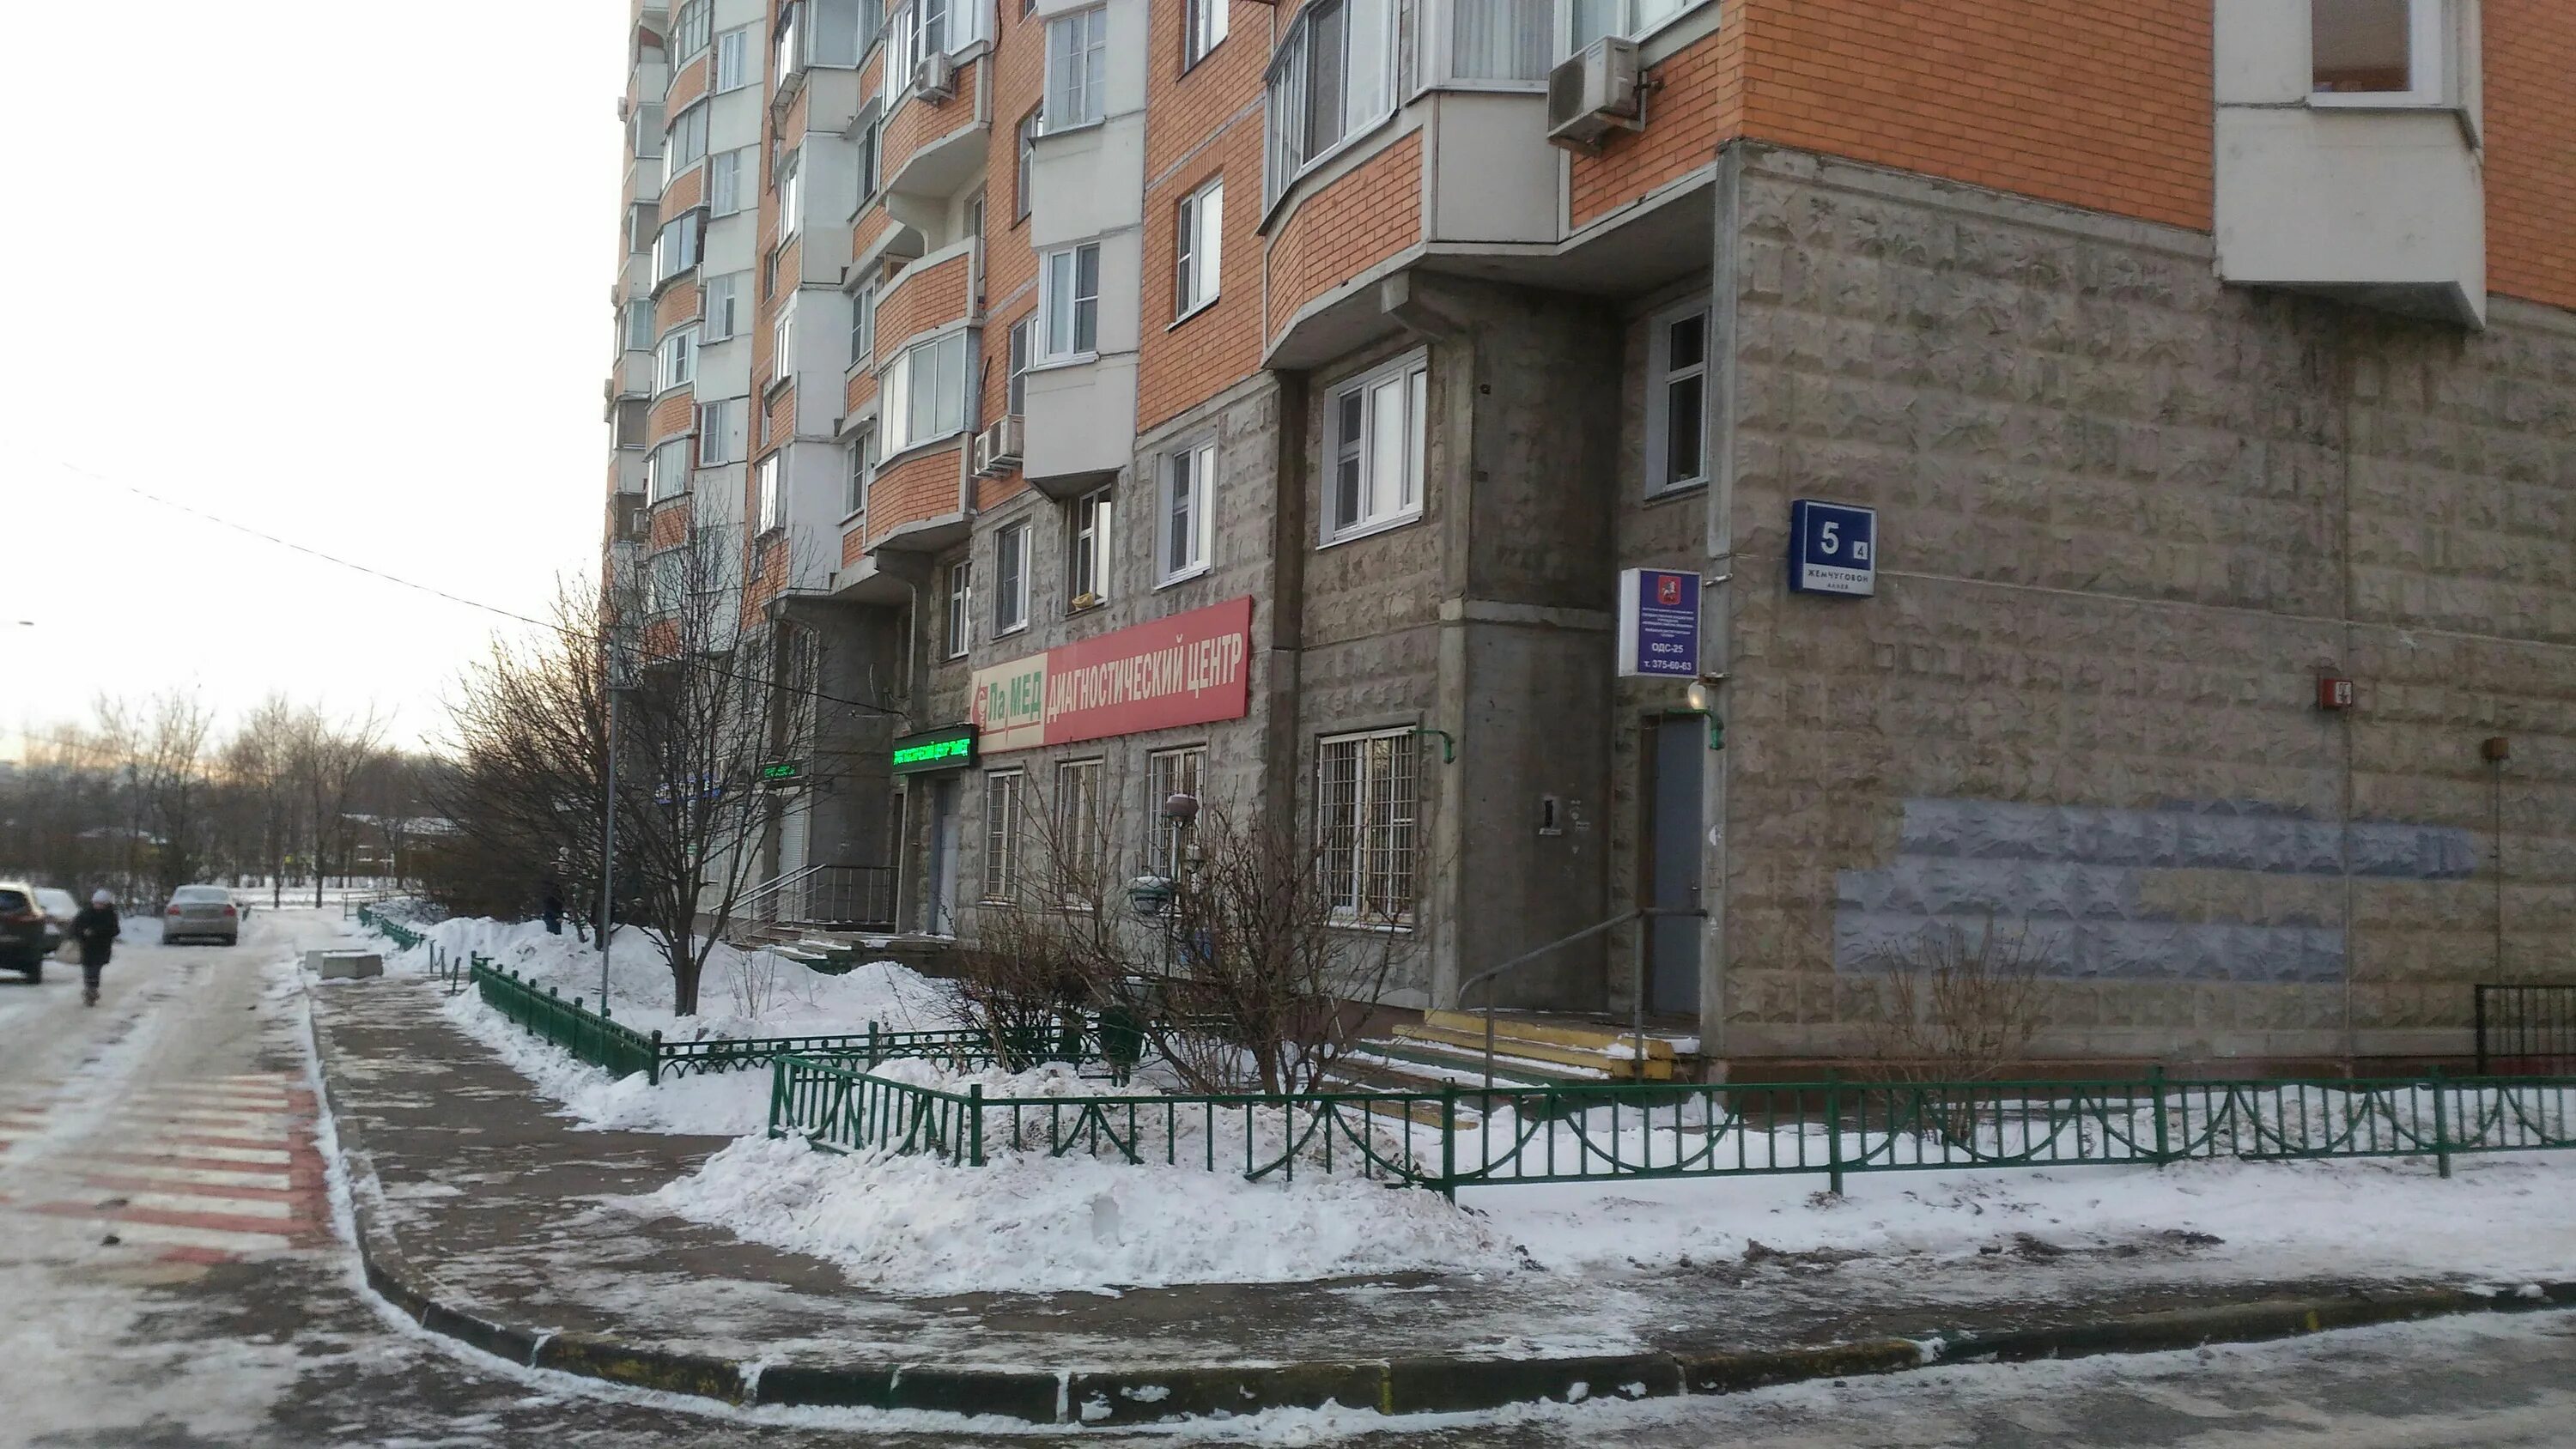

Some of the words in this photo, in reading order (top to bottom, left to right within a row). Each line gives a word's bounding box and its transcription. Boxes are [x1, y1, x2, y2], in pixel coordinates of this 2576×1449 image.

[1821, 521, 1839, 555] 5
[1857, 545, 1864, 557] 4
[1651, 642, 1684, 653] ОДС-25
[987, 682, 1005, 722] Ла
[1010, 670, 1042, 722] МЕД
[1046, 634, 1184, 724] ДИАГНОСТИЧЕСКИЙ
[1187, 632, 1243, 699] ЦЕНТР
